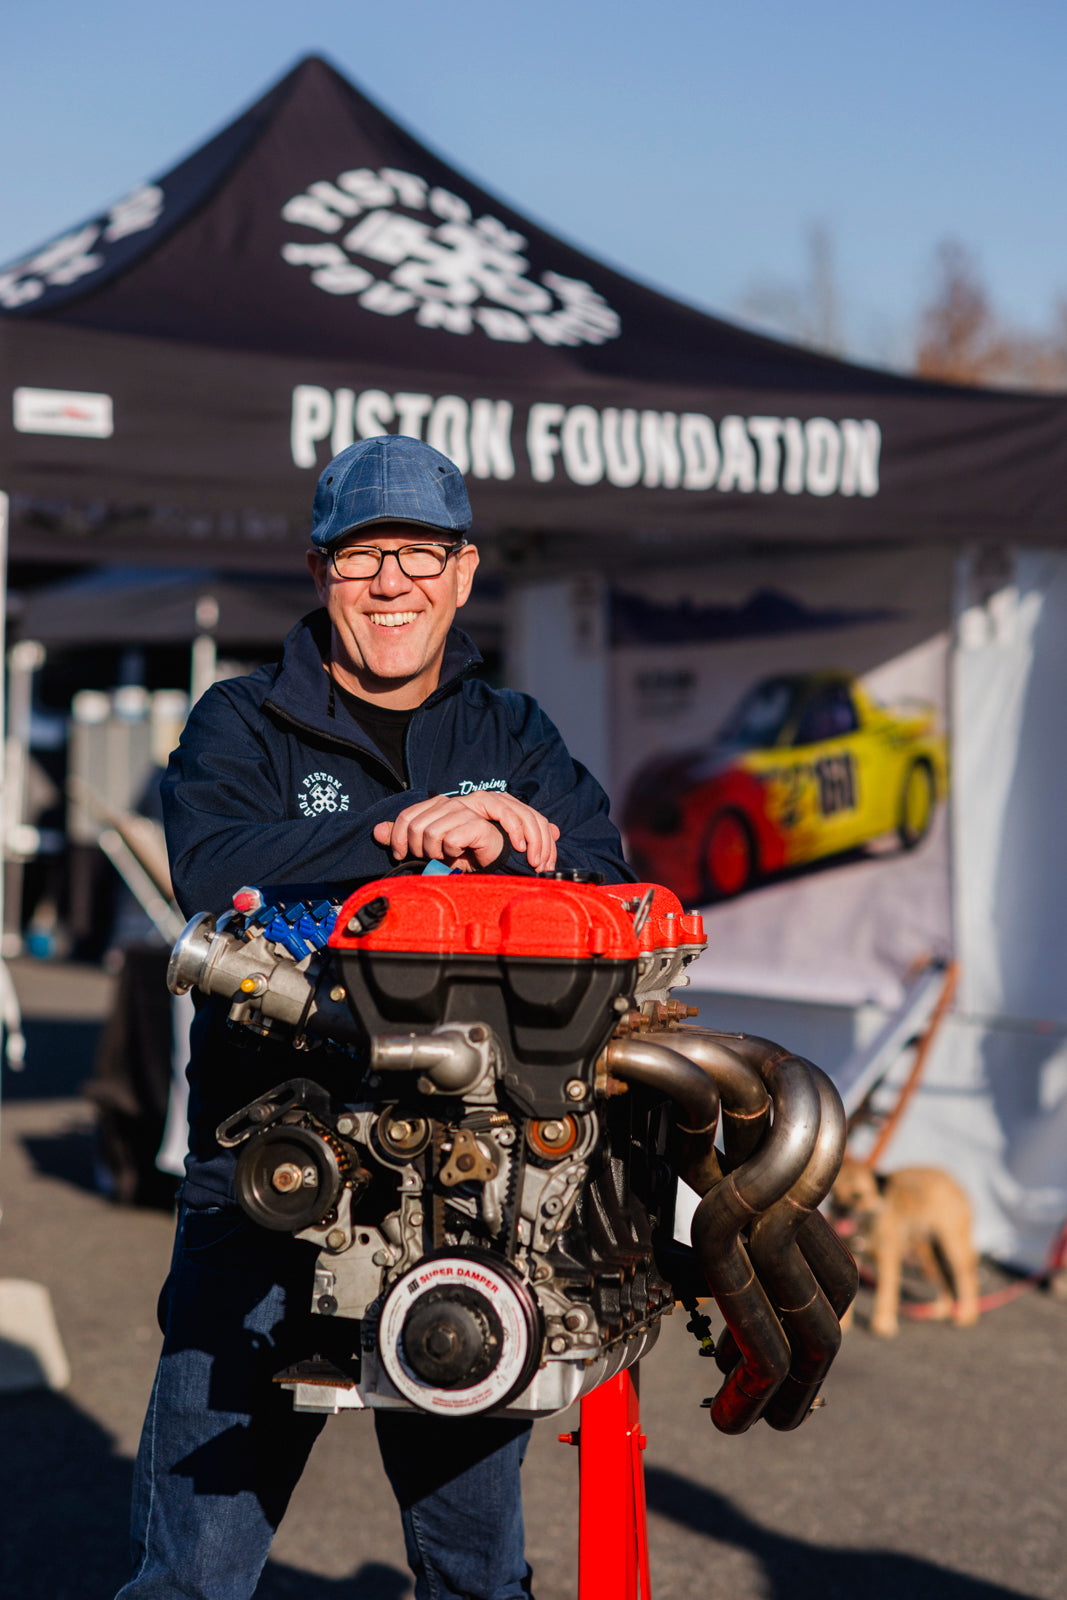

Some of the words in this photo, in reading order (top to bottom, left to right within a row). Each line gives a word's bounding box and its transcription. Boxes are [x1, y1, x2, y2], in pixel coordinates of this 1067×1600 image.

[291, 384, 515, 481] PISTON
[527, 401, 882, 497] FOUNDATION
[302, 771, 343, 790] PISTON
[459, 778, 507, 796] Driving
[419, 1268, 454, 1285] SUPER
[456, 1267, 499, 1294] DAMPER
